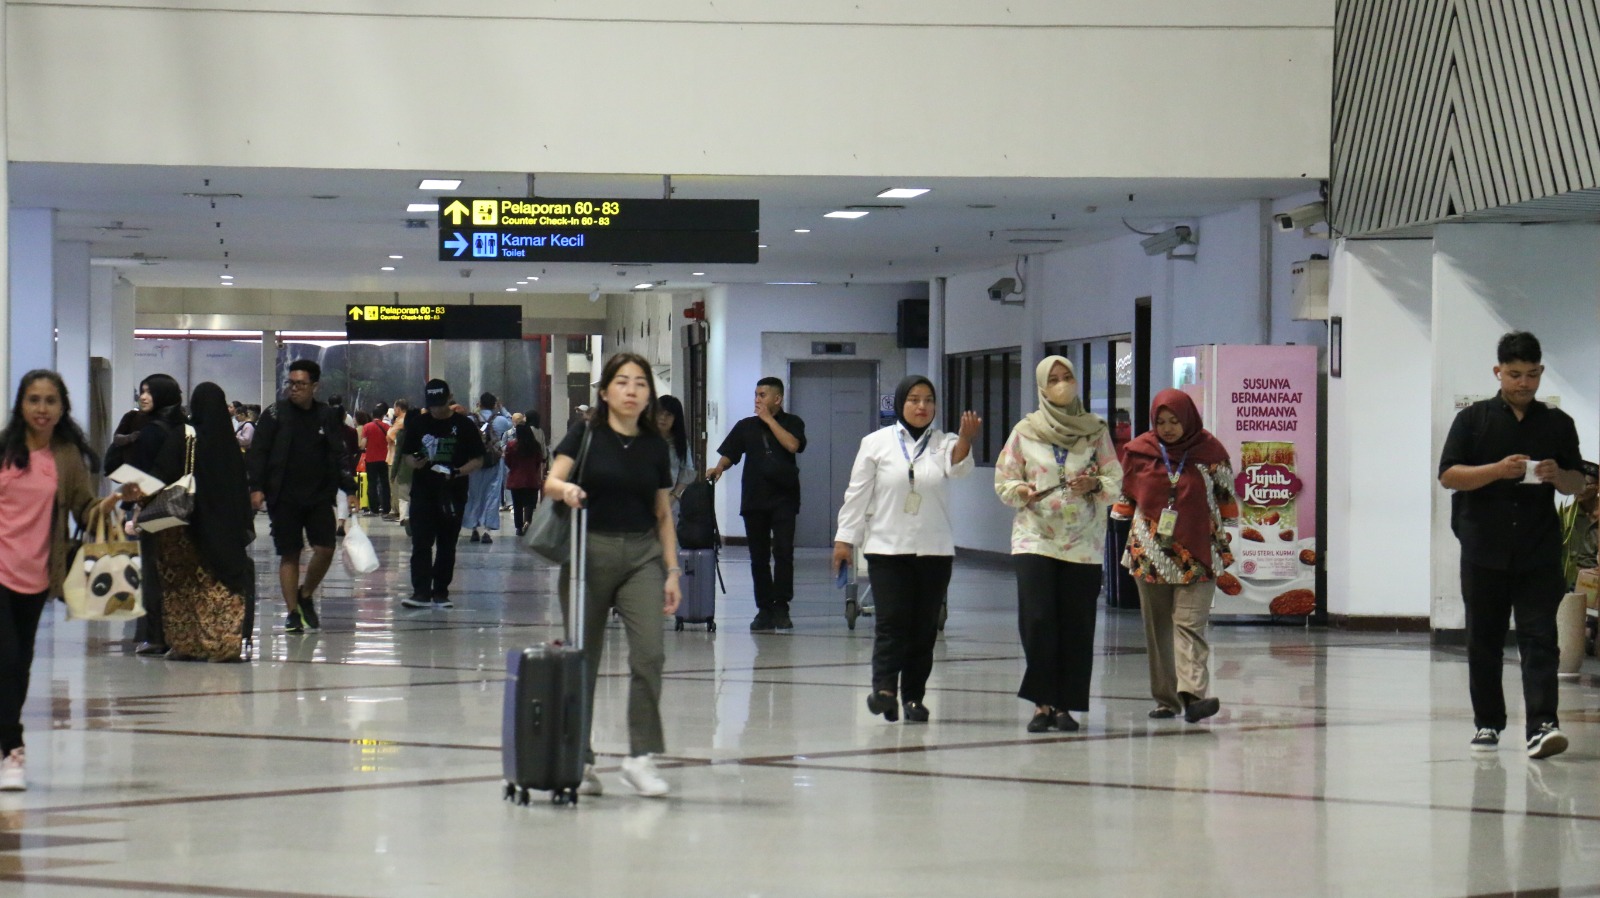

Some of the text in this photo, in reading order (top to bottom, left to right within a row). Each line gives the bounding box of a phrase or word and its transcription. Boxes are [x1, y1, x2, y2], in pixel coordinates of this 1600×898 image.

[501, 200, 571, 217] Pelaporan
[501, 216, 538, 225] Counter
[539, 217, 580, 226] Check-In
[501, 233, 584, 247] Kamar Kecil
[502, 248, 526, 257] Toilet
[380, 306, 419, 315] Pelaporan
[1243, 378, 1291, 390] SUSUNYA
[1231, 392, 1303, 403] BERMANFAAT
[1236, 406, 1297, 417] KURMANYA
[1236, 420, 1298, 431] BERKHASIAT
[1245, 465, 1291, 488] Tujuh
[1243, 483, 1290, 504] Kurma
